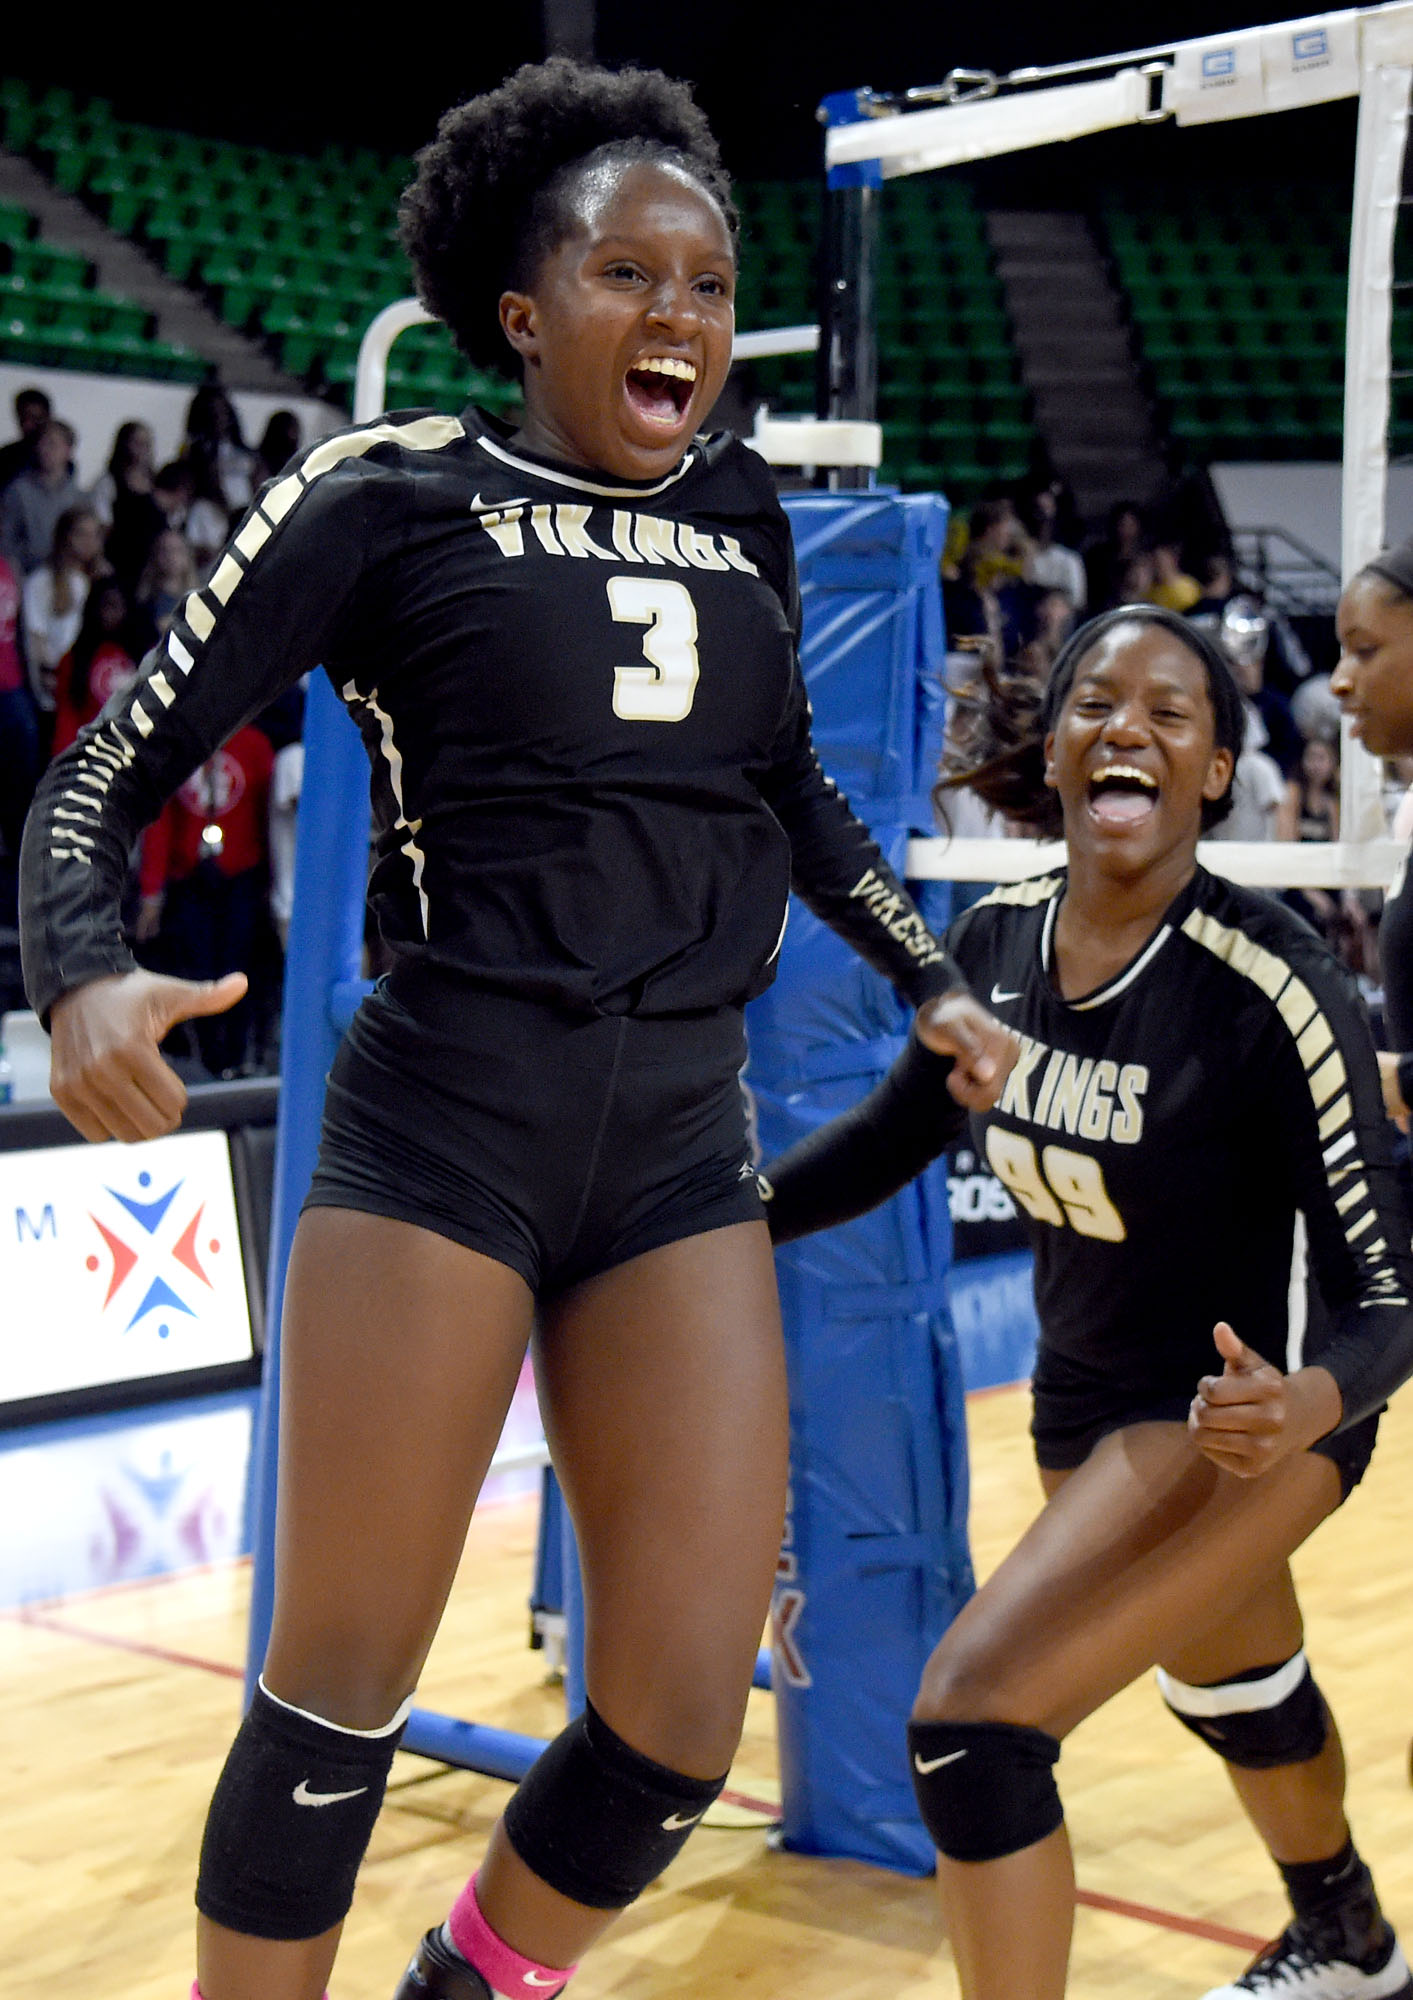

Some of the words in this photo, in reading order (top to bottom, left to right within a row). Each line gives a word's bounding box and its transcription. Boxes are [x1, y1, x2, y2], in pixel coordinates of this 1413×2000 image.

[479, 504, 759, 577] VIKINGS
[606, 576, 699, 722] 3
[992, 1018, 1149, 1144] KINGS
[16, 1203, 57, 1242] M
[986, 1125, 1128, 1243] 99
